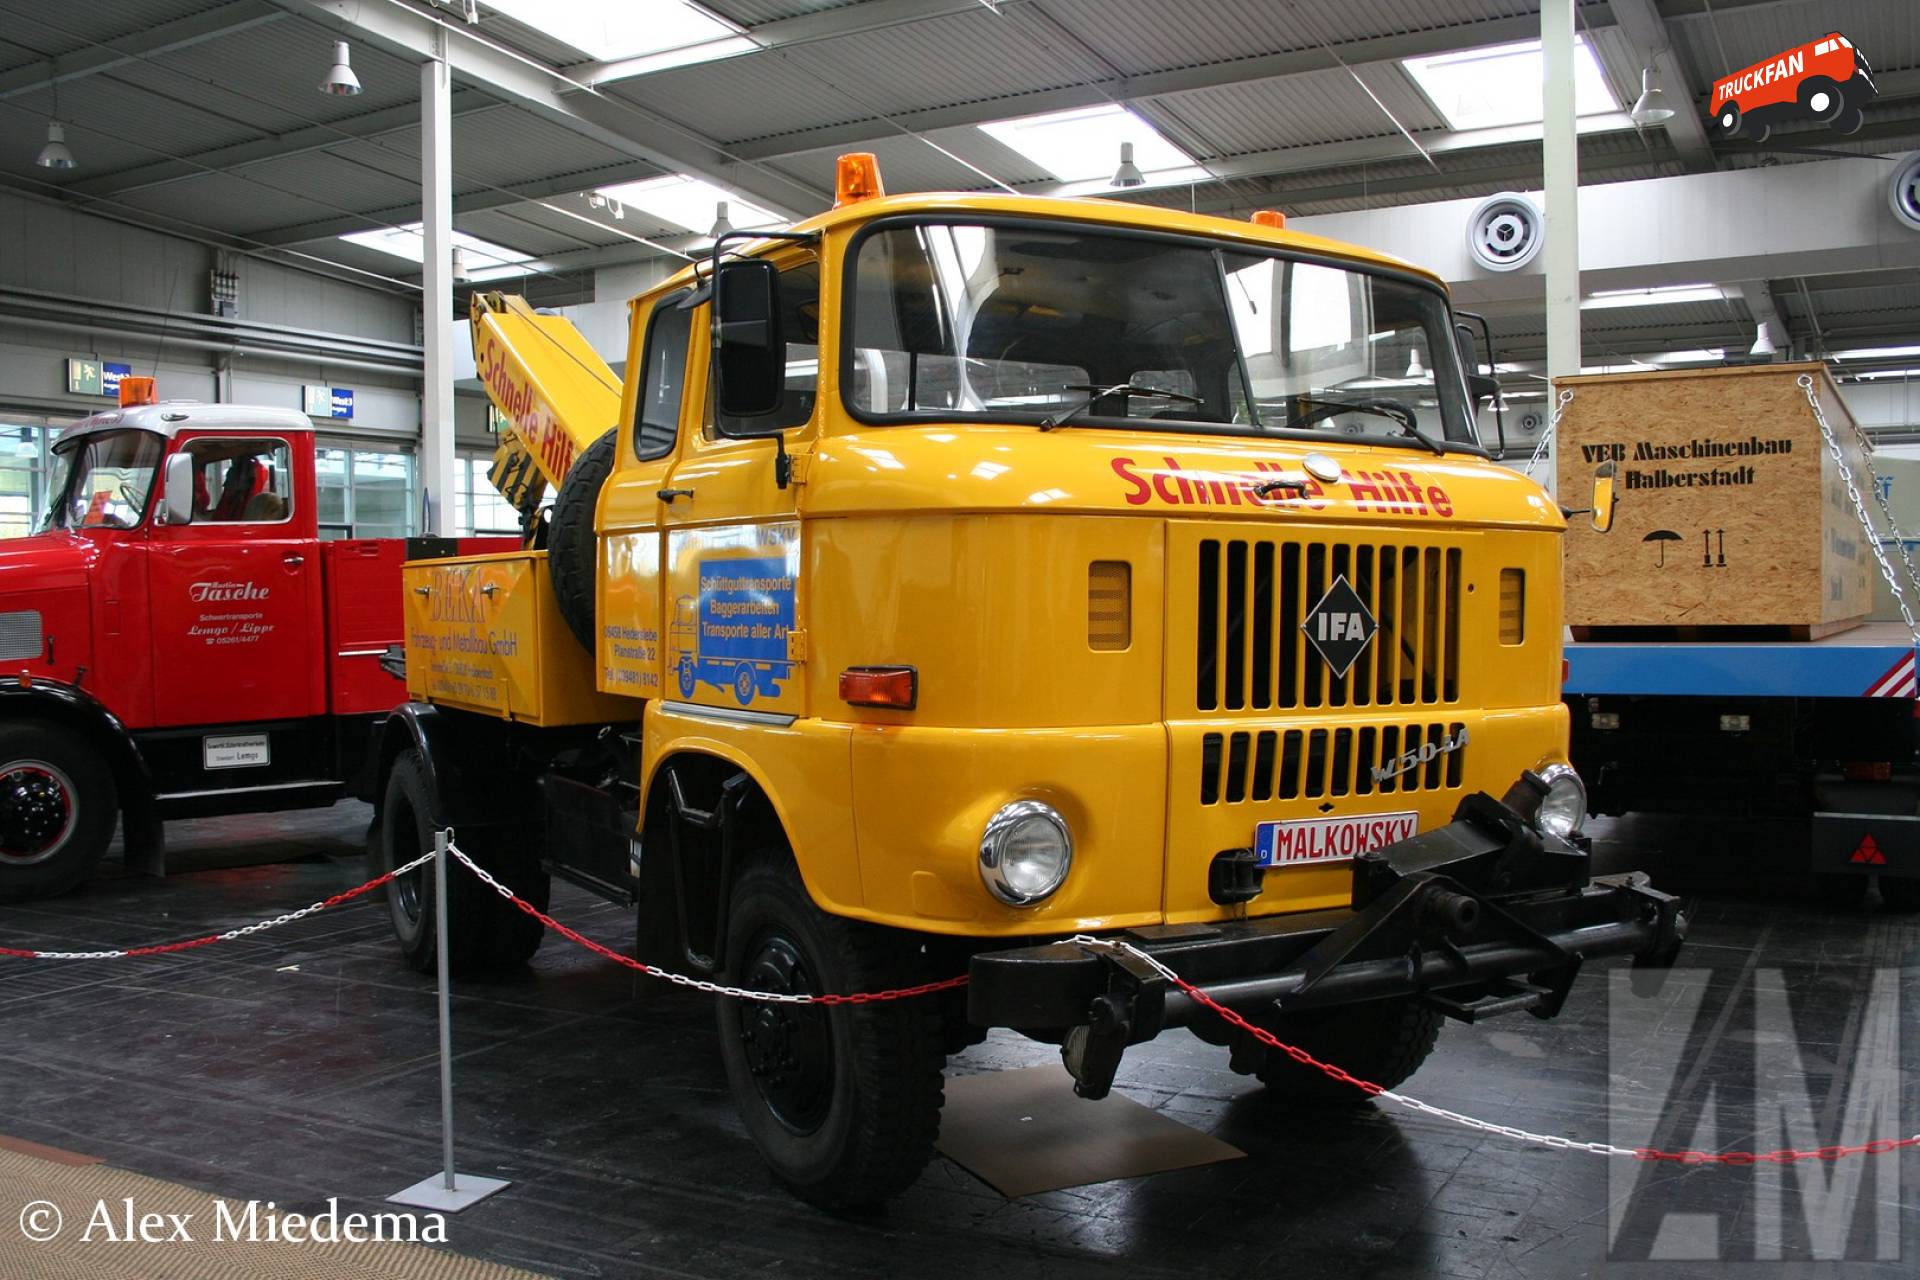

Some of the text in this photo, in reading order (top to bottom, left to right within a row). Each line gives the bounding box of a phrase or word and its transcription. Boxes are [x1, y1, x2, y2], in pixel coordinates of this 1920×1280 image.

[540, 415, 574, 482] Hilf
[1581, 436, 1793, 463] VEB Maschinenbau
[1625, 465, 1755, 490] Halberstadt
[1341, 468, 1455, 518] Hilfe
[700, 574, 793, 597] Schüttguttransporte
[710, 599, 780, 618] Baggerarbeiten
[187, 625, 229, 638] Lemgo
[240, 622, 275, 634] Lippe
[703, 621, 790, 641] Transporte aller Art
[1317, 612, 1365, 641] IFA
[488, 630, 518, 656] GmbH
[646, 647, 657, 661] 22
[1276, 818, 1414, 862] MALKOWSKY
